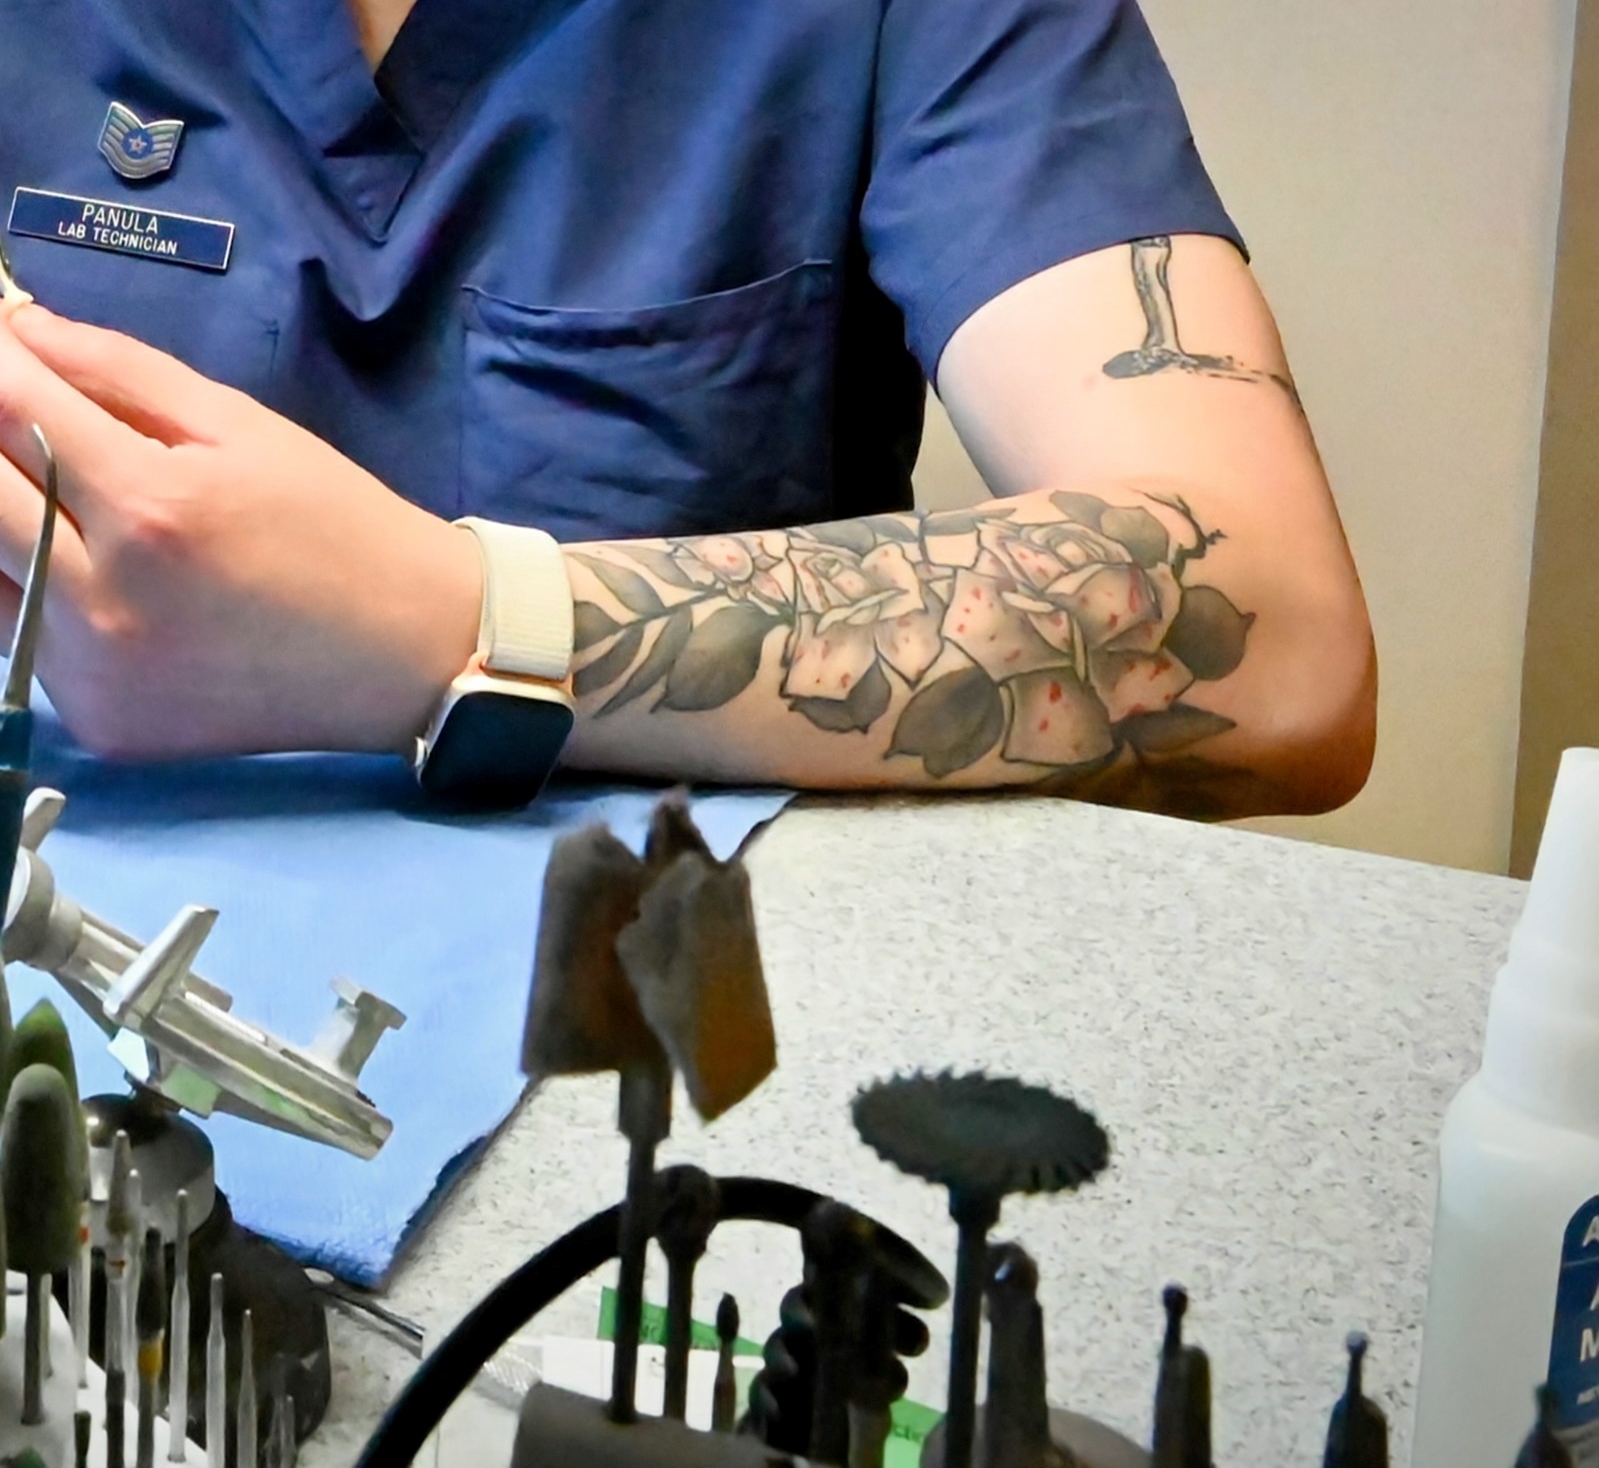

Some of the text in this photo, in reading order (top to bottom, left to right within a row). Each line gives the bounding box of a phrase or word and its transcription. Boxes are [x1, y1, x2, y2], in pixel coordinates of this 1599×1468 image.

[82, 204, 158, 235] PANULA
[57, 221, 178, 256] LAB TECHNICIAN
